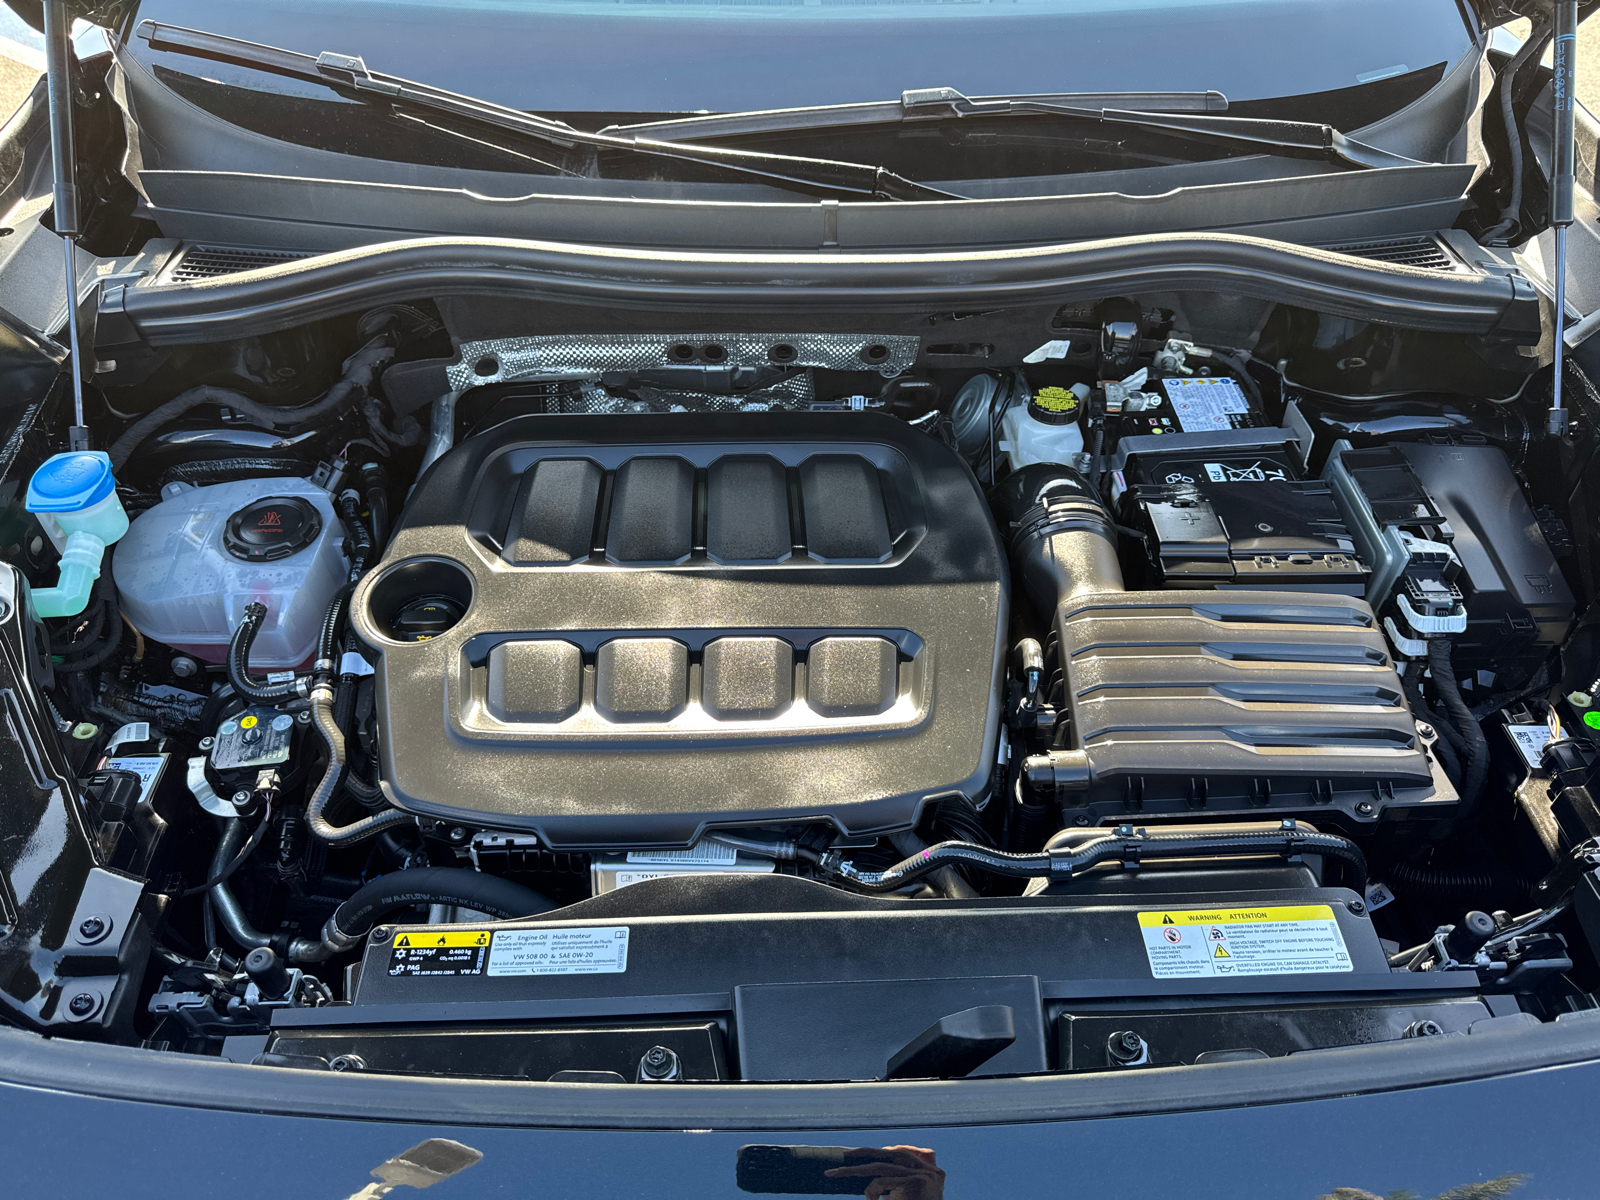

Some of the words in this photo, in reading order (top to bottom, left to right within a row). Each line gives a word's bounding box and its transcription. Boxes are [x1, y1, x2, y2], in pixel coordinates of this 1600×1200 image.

[1210, 470, 1222, 480] Pb
[439, 896, 458, 904] ARTIC
[470, 900, 483, 909] LEV
